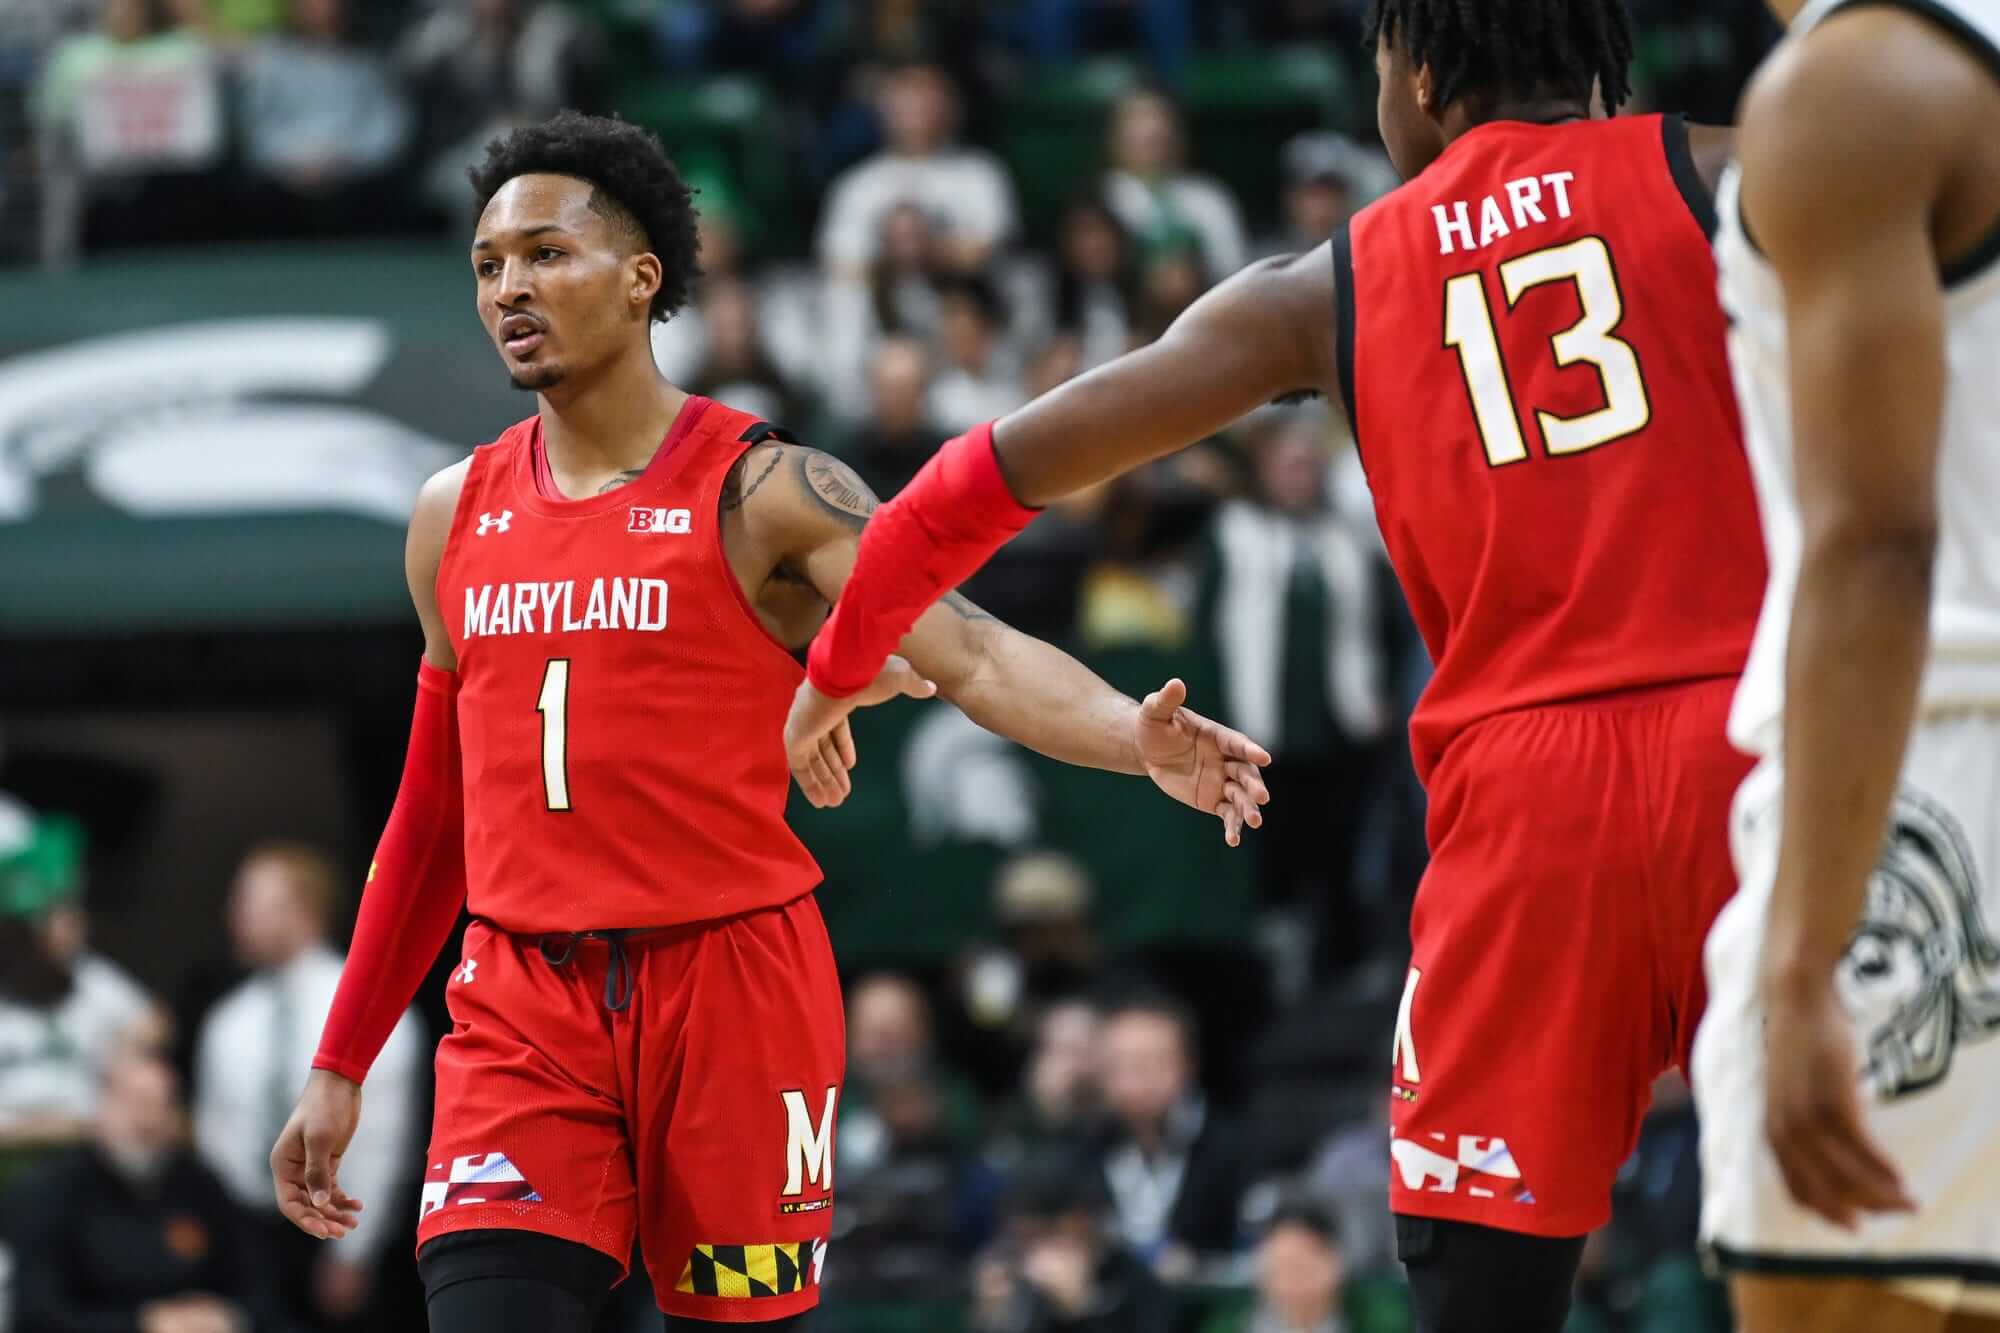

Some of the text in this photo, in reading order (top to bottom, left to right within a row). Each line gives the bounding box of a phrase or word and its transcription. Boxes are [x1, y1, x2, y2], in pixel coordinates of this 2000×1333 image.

[1431, 171, 1574, 255] HART
[1441, 235, 1652, 467] 13
[463, 577, 668, 640] MARYLAND
[536, 658, 572, 812] 1
[780, 1085, 837, 1196] M
